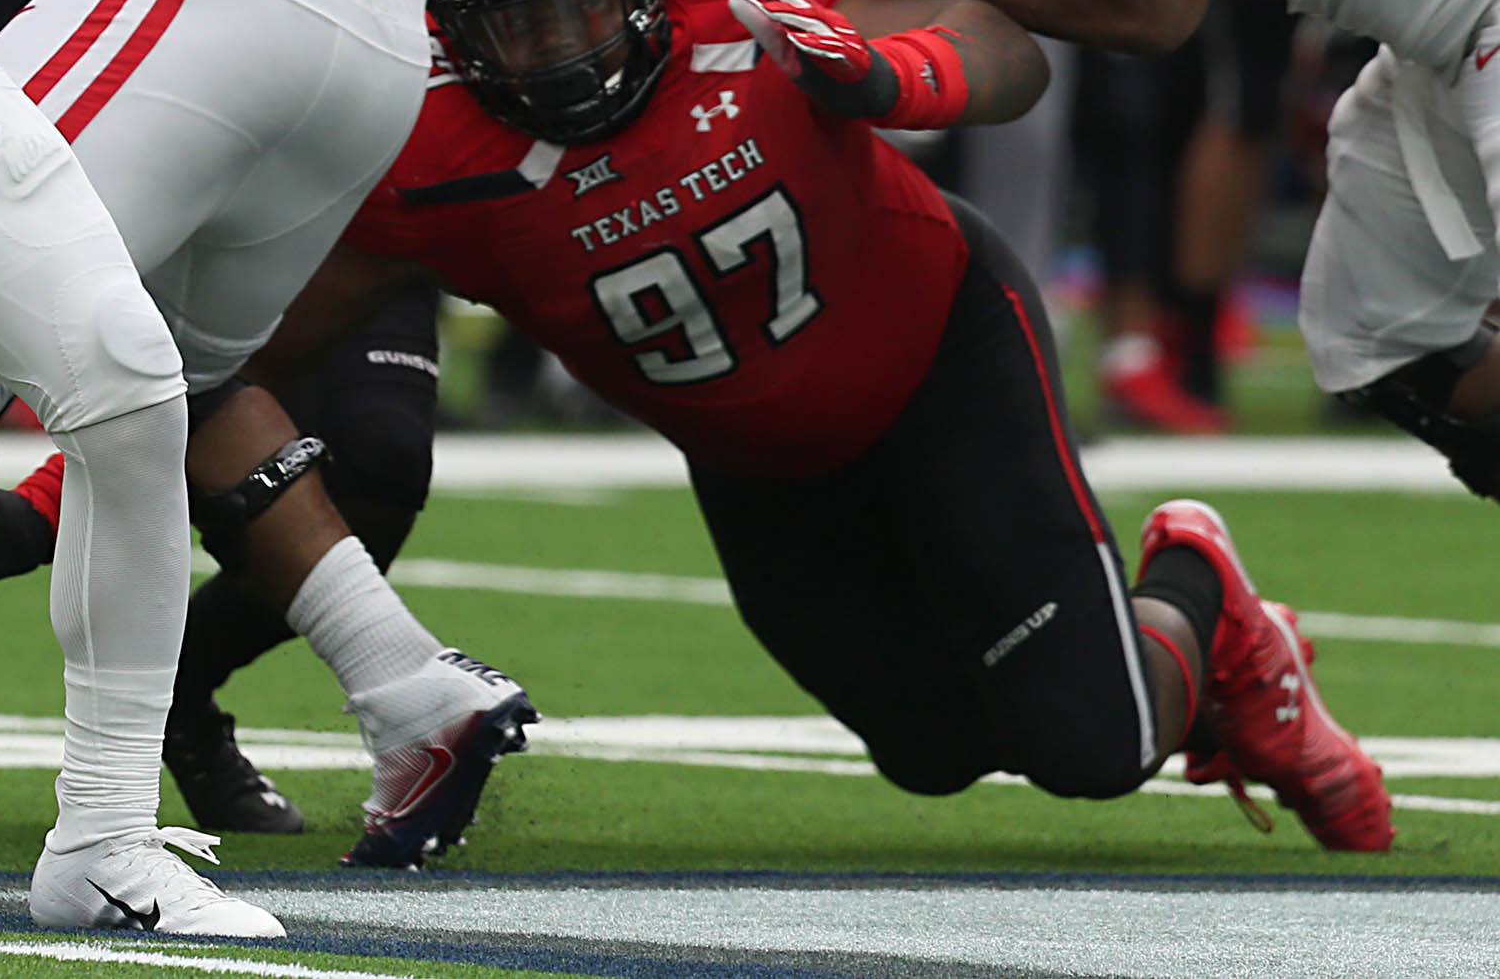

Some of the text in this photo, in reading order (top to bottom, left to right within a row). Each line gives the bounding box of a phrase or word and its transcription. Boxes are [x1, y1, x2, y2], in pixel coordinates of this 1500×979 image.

[570, 137, 765, 252] TEXAS TECH
[587, 180, 825, 386] 97
